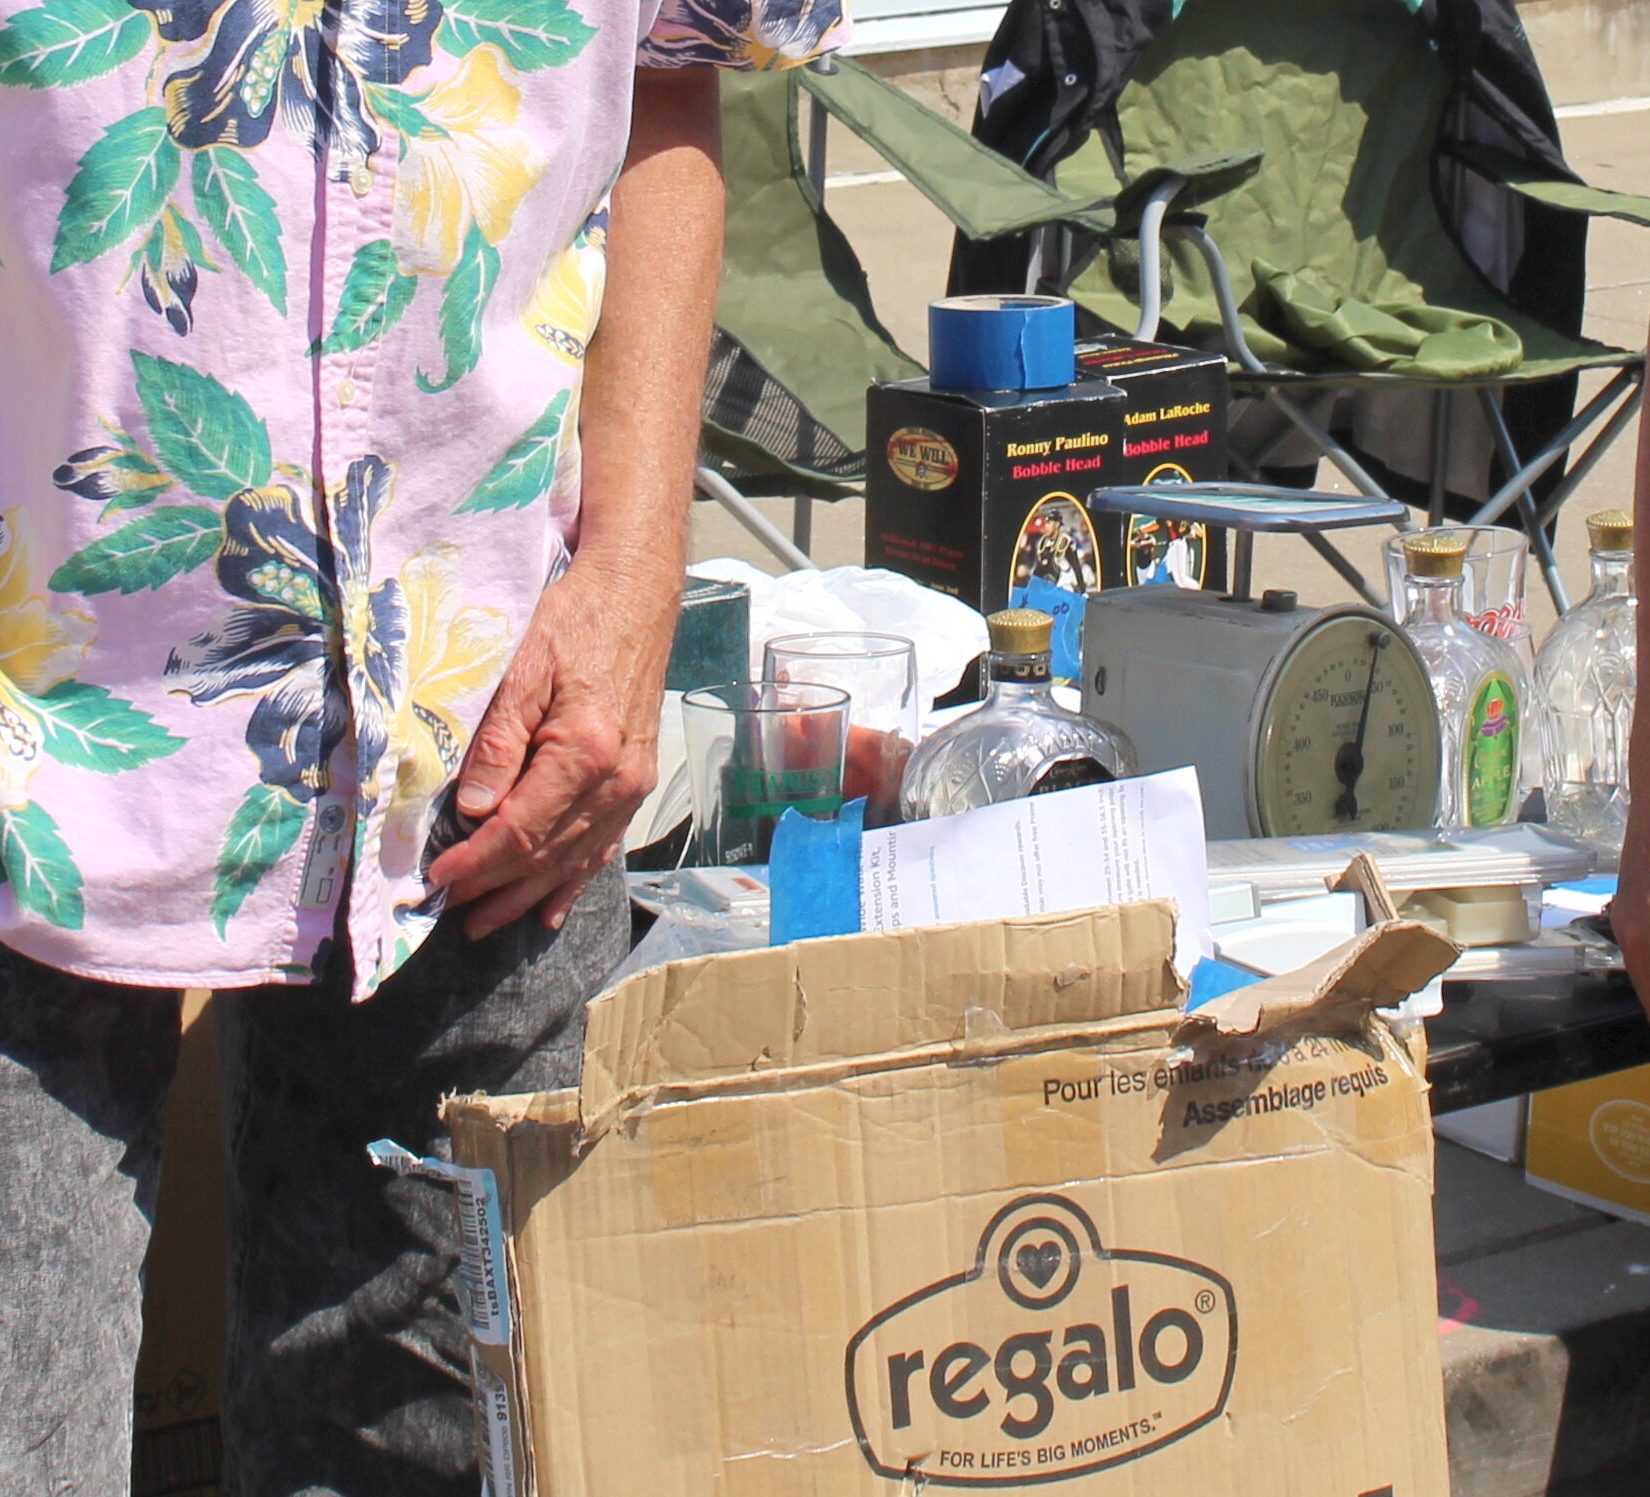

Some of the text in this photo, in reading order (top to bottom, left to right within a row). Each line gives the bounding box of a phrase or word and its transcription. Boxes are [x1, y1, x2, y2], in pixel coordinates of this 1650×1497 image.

[1124, 401, 1211, 426] Adam LaRoche
[898, 442, 948, 465] WE WILL
[1006, 432, 1109, 459] Ronny Paulino
[1123, 429, 1210, 458] Bobble Head
[1012, 455, 1101, 480] Bobble Head
[1387, 723, 1404, 738] 100
[1294, 737, 1311, 752] 400
[1389, 775, 1405, 791] 150
[1295, 791, 1312, 806] 350
[888, 884, 899, 908] and
[1043, 1077, 1102, 1106] Pour
[1111, 1071, 1146, 1096] les
[1183, 1063, 1389, 1129] Assemblage requis
[887, 1284, 1204, 1440] regalo
[940, 1450, 975, 1468] FOR
[980, 1448, 1032, 1469] LIFE'S
[1037, 1445, 1067, 1464] BIG
